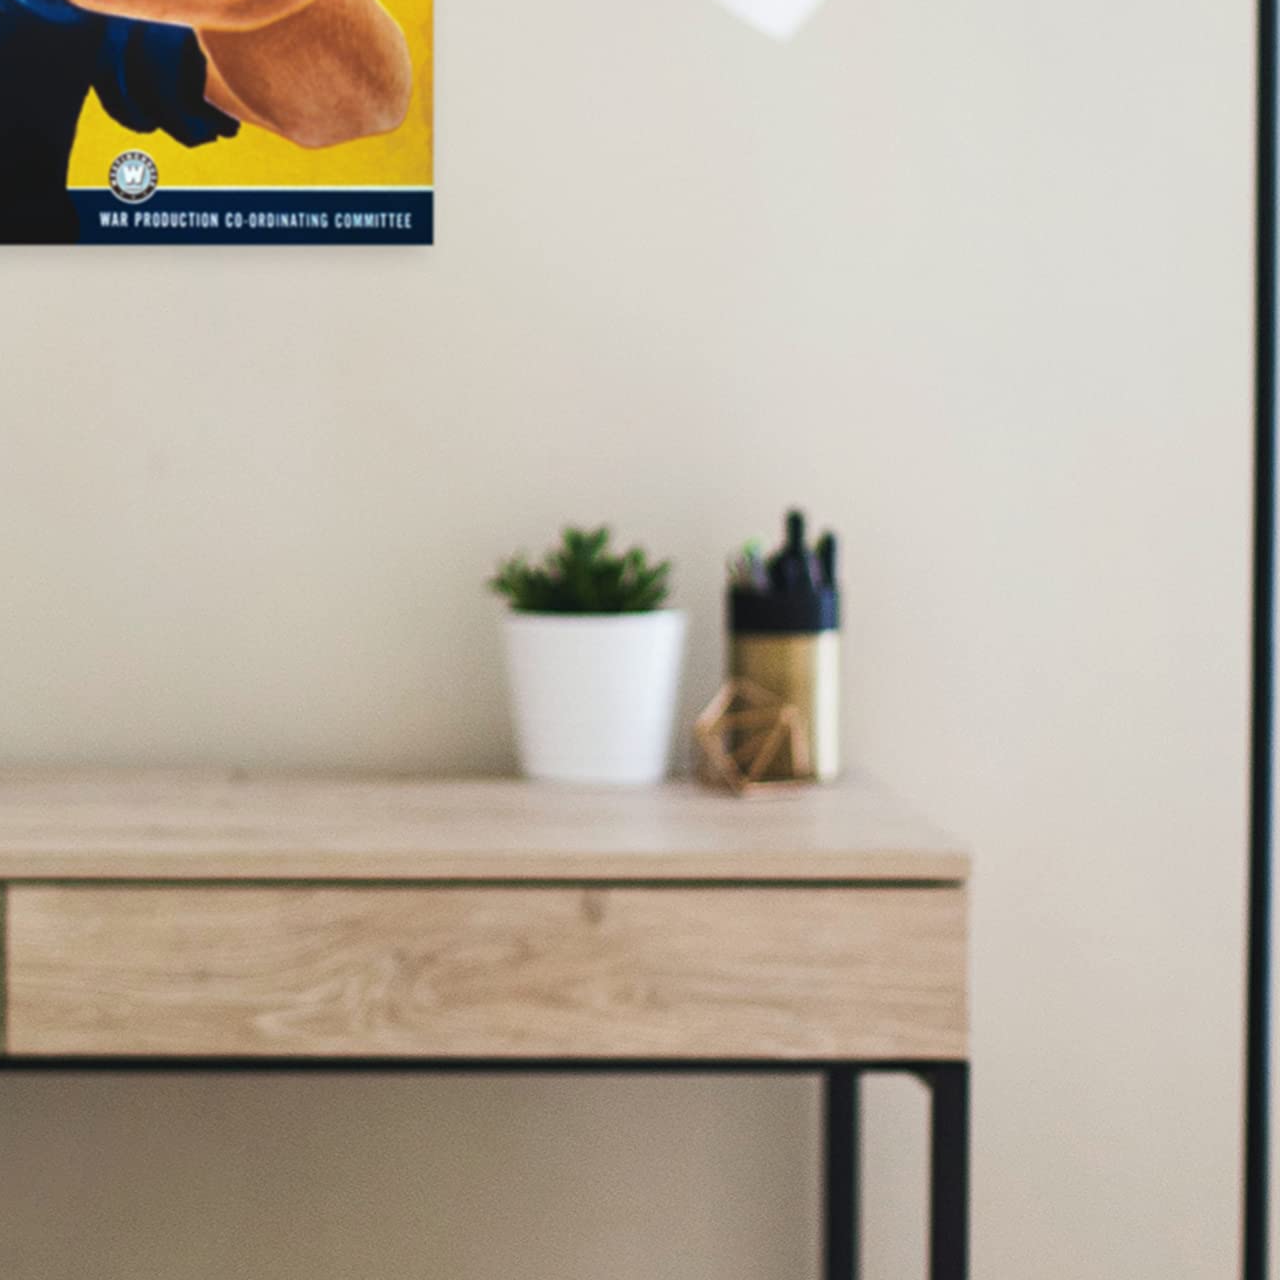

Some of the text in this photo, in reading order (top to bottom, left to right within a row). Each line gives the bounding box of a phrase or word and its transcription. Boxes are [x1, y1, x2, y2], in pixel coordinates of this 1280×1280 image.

[122, 163, 145, 185] W
[99, 211, 412, 229] WAR PRODUCTION CO-ORDINATING COMMITTEE
